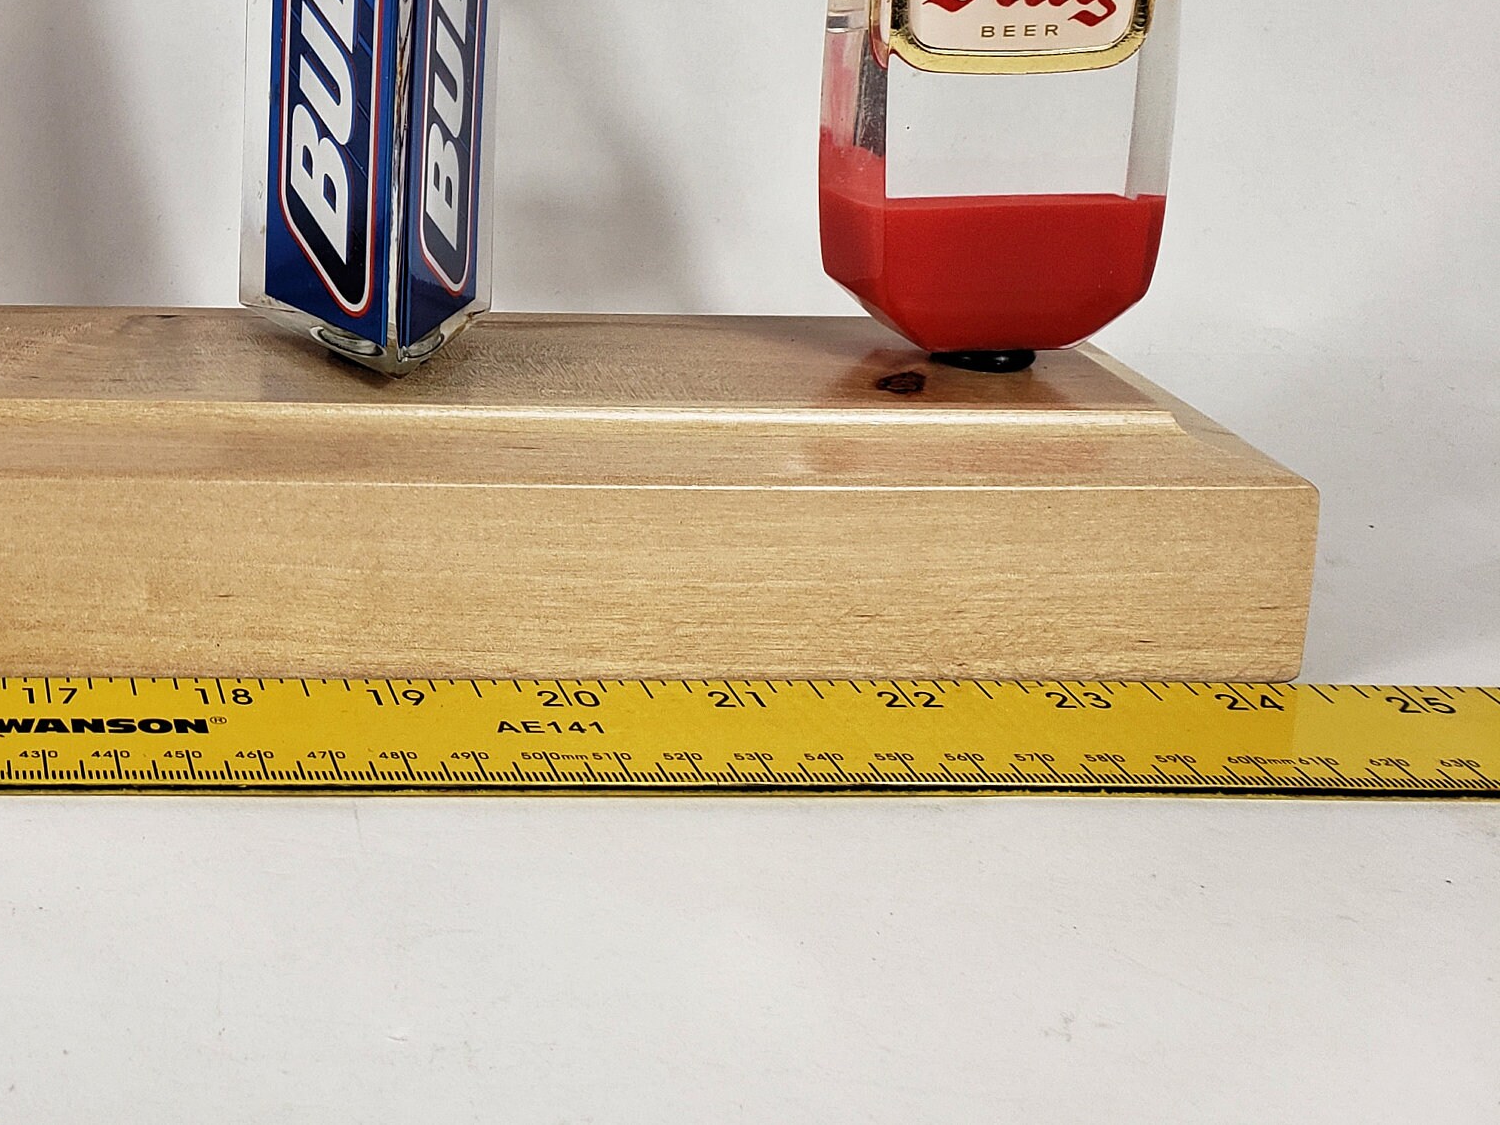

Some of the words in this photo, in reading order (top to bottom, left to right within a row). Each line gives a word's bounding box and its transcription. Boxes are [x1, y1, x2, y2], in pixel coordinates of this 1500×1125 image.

[980, 24, 1061, 38] BEER
[22, 687, 78, 704] 17
[194, 687, 253, 705] 18
[366, 688, 425, 706] 19
[536, 689, 601, 707] 20
[707, 691, 767, 707] 21
[877, 691, 944, 708] 22
[1045, 691, 1112, 709] 23
[1214, 693, 1285, 711] 24
[1385, 696, 1457, 714] 25
[497, 720, 605, 734] AE141
[18, 750, 59, 759] 430
[90, 750, 131, 759] 440
[163, 750, 203, 759] 450
[235, 750, 275, 760] 460
[306, 750, 347, 760] 470
[378, 751, 419, 761] 480
[450, 751, 490, 761] 490
[591, 751, 632, 761] 510
[662, 752, 704, 762] 520
[733, 752, 774, 762] 530
[803, 752, 845, 762] 540
[873, 752, 915, 762] 550
[943, 752, 985, 762] 560
[1013, 753, 1055, 762] 570
[1083, 753, 1126, 763] 580
[1154, 754, 1198, 764] 590
[1298, 756, 1340, 766] 610
[1368, 758, 1411, 768] 620
[1439, 759, 1481, 769] 630
